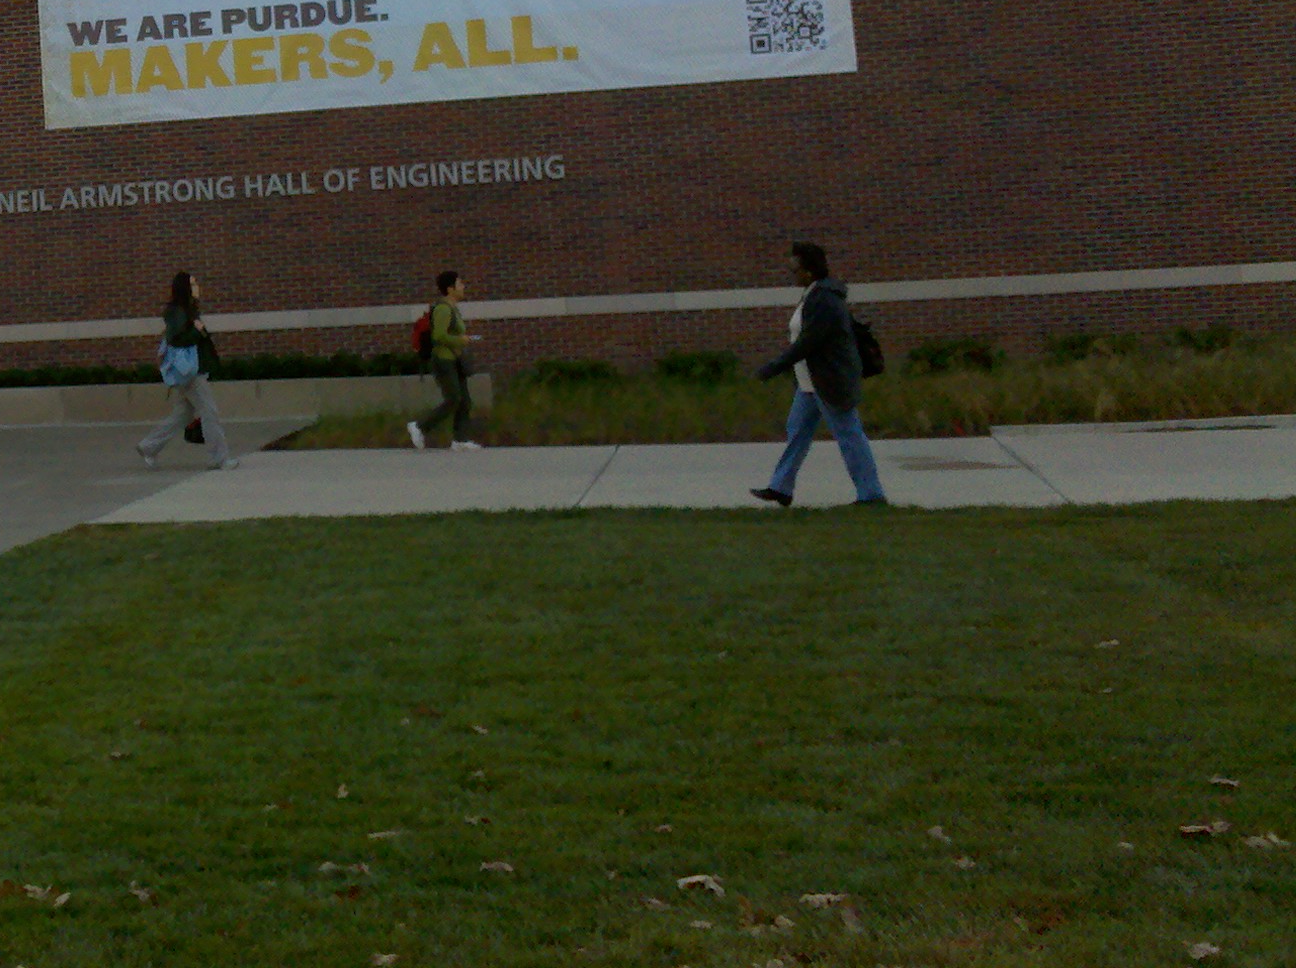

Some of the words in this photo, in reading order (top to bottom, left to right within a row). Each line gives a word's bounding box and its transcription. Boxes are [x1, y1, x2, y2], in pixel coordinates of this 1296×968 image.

[65, 17, 128, 46] WE
[136, 10, 212, 41] ARE
[69, 28, 394, 97] MAKERS,
[413, 14, 578, 71] ALL.
[59, 176, 235, 210] ARMSTRONG
[244, 171, 315, 198] HALL
[323, 167, 360, 193] OF
[370, 155, 565, 191] ENGINEERING
